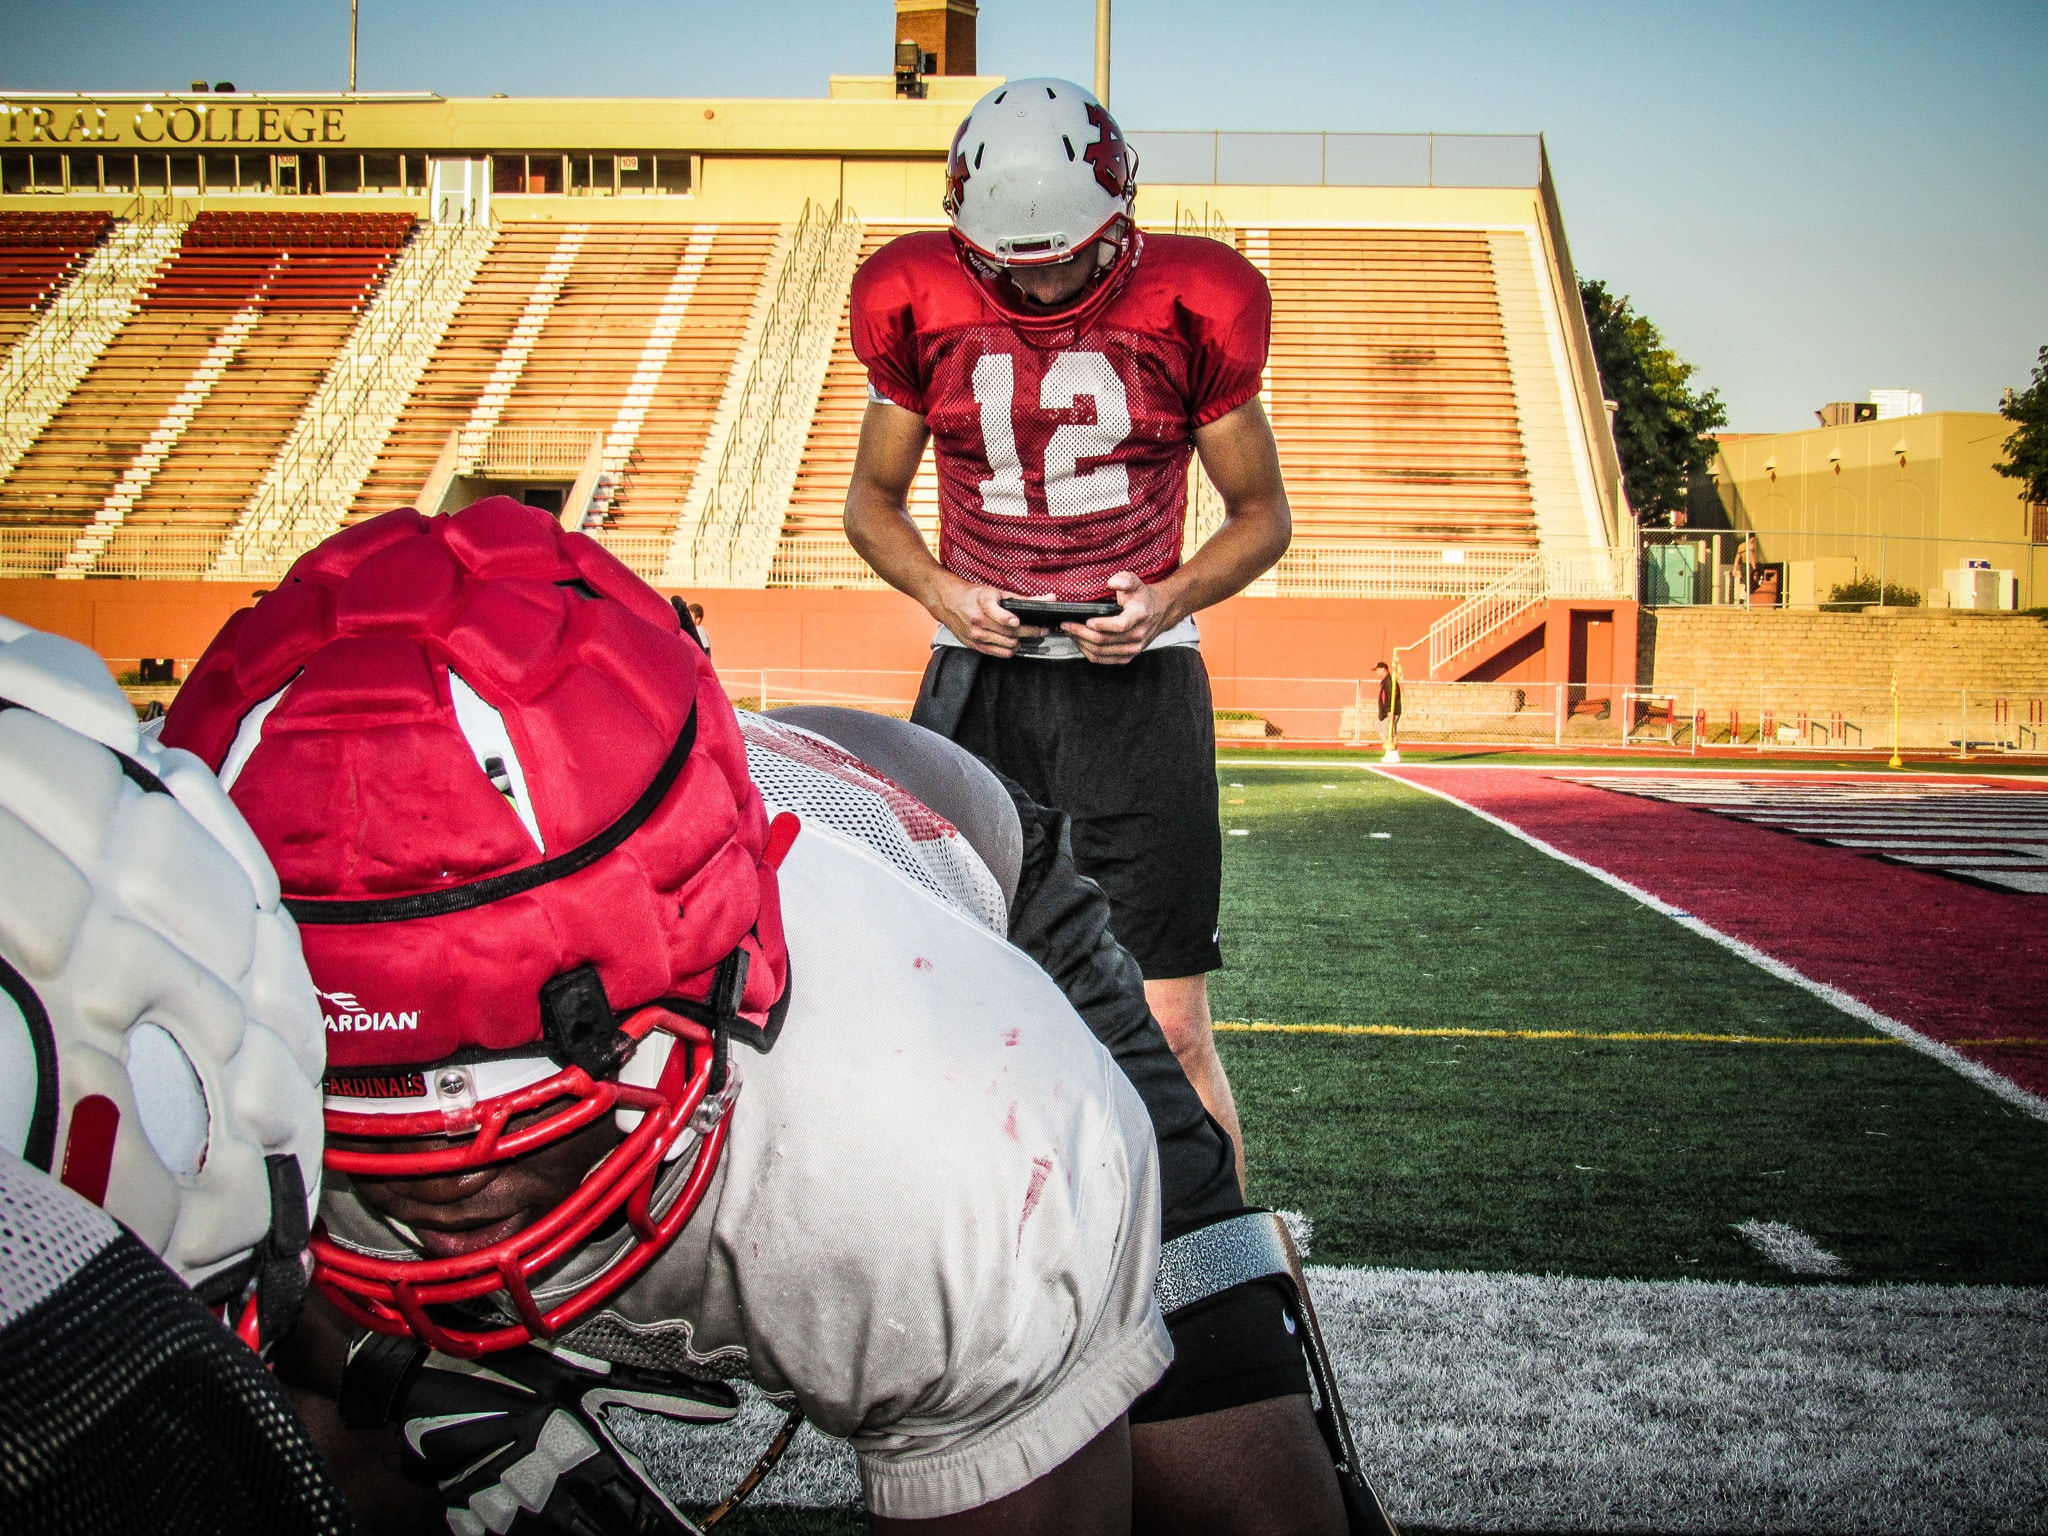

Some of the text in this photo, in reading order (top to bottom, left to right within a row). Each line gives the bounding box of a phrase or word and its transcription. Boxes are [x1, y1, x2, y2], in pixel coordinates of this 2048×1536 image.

[133, 106, 346, 143] COLLEGE
[622, 158, 636, 168] 109
[971, 351, 1132, 517] 12
